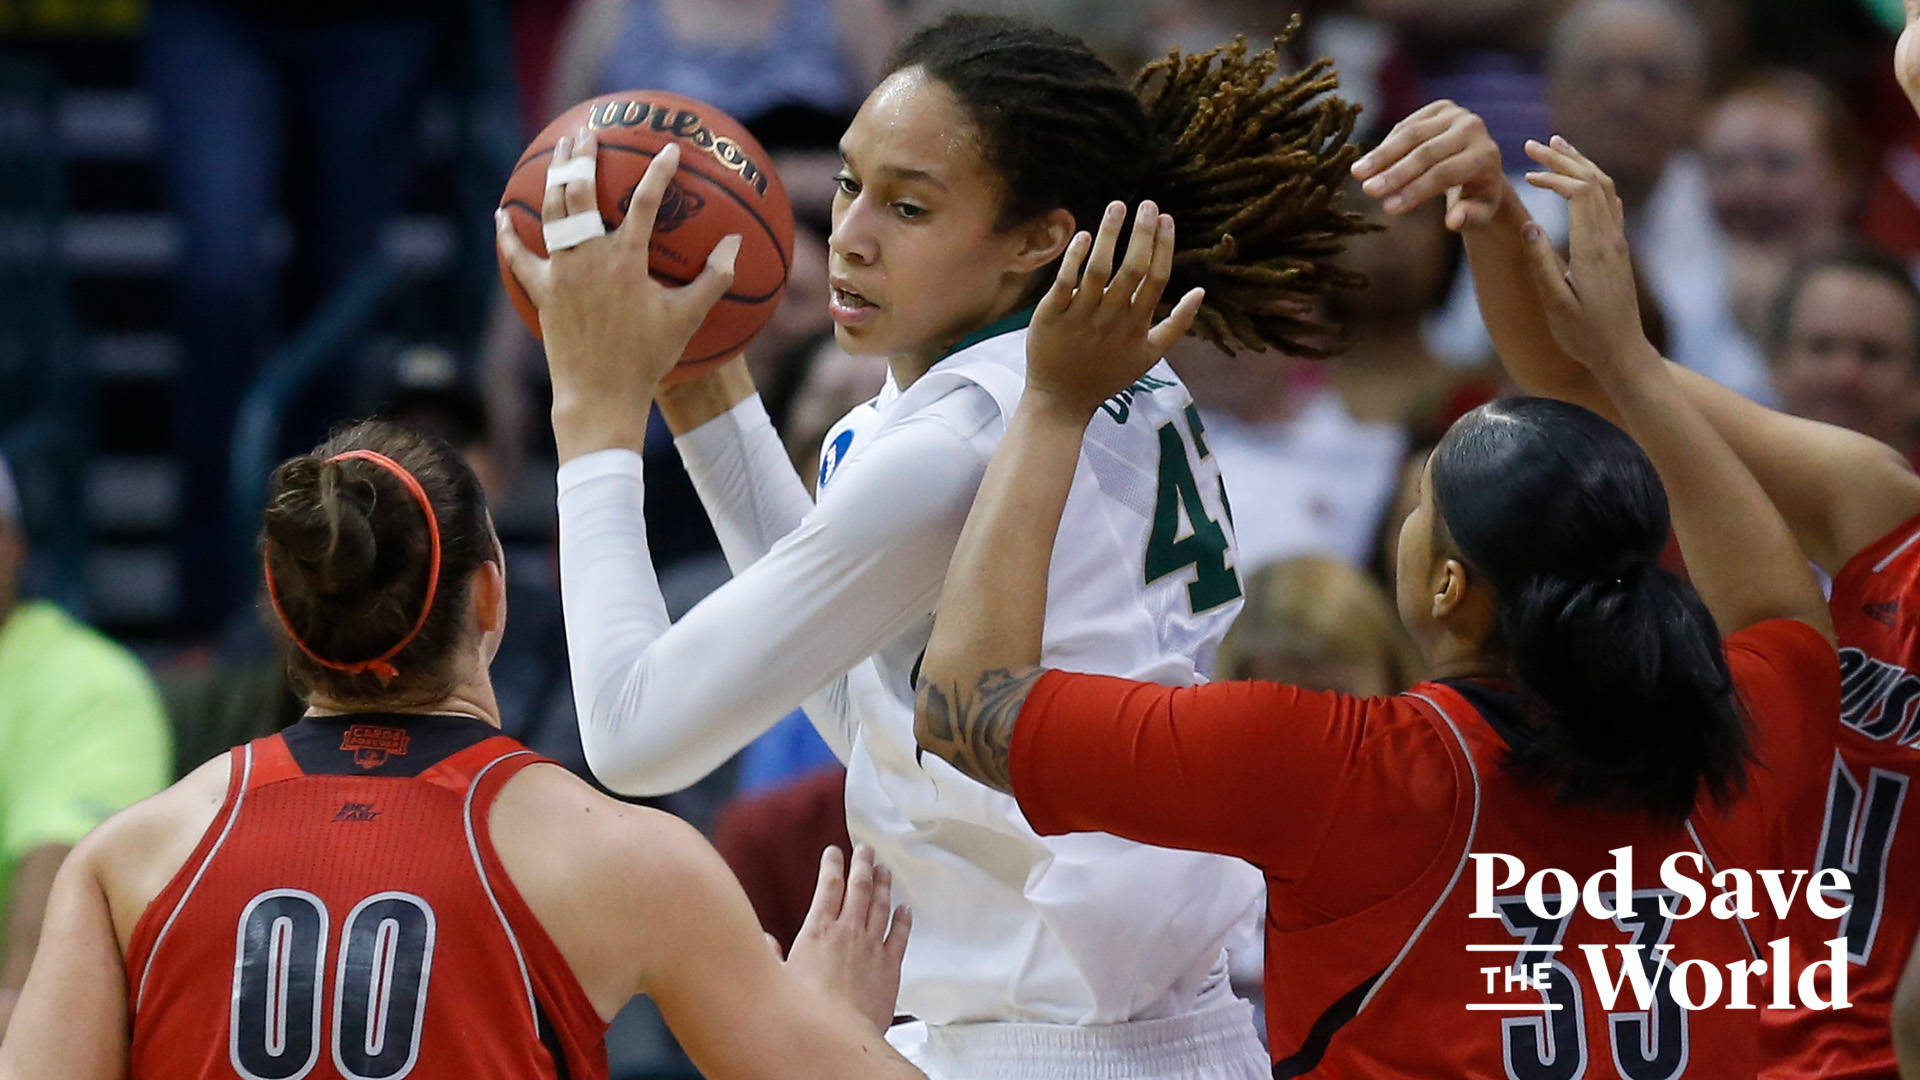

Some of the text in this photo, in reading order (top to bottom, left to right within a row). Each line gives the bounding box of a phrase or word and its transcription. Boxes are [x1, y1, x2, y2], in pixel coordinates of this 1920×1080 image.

[587, 101, 769, 196] Wilson
[229, 888, 437, 1080] 00
[1494, 889, 1690, 1080] 33
